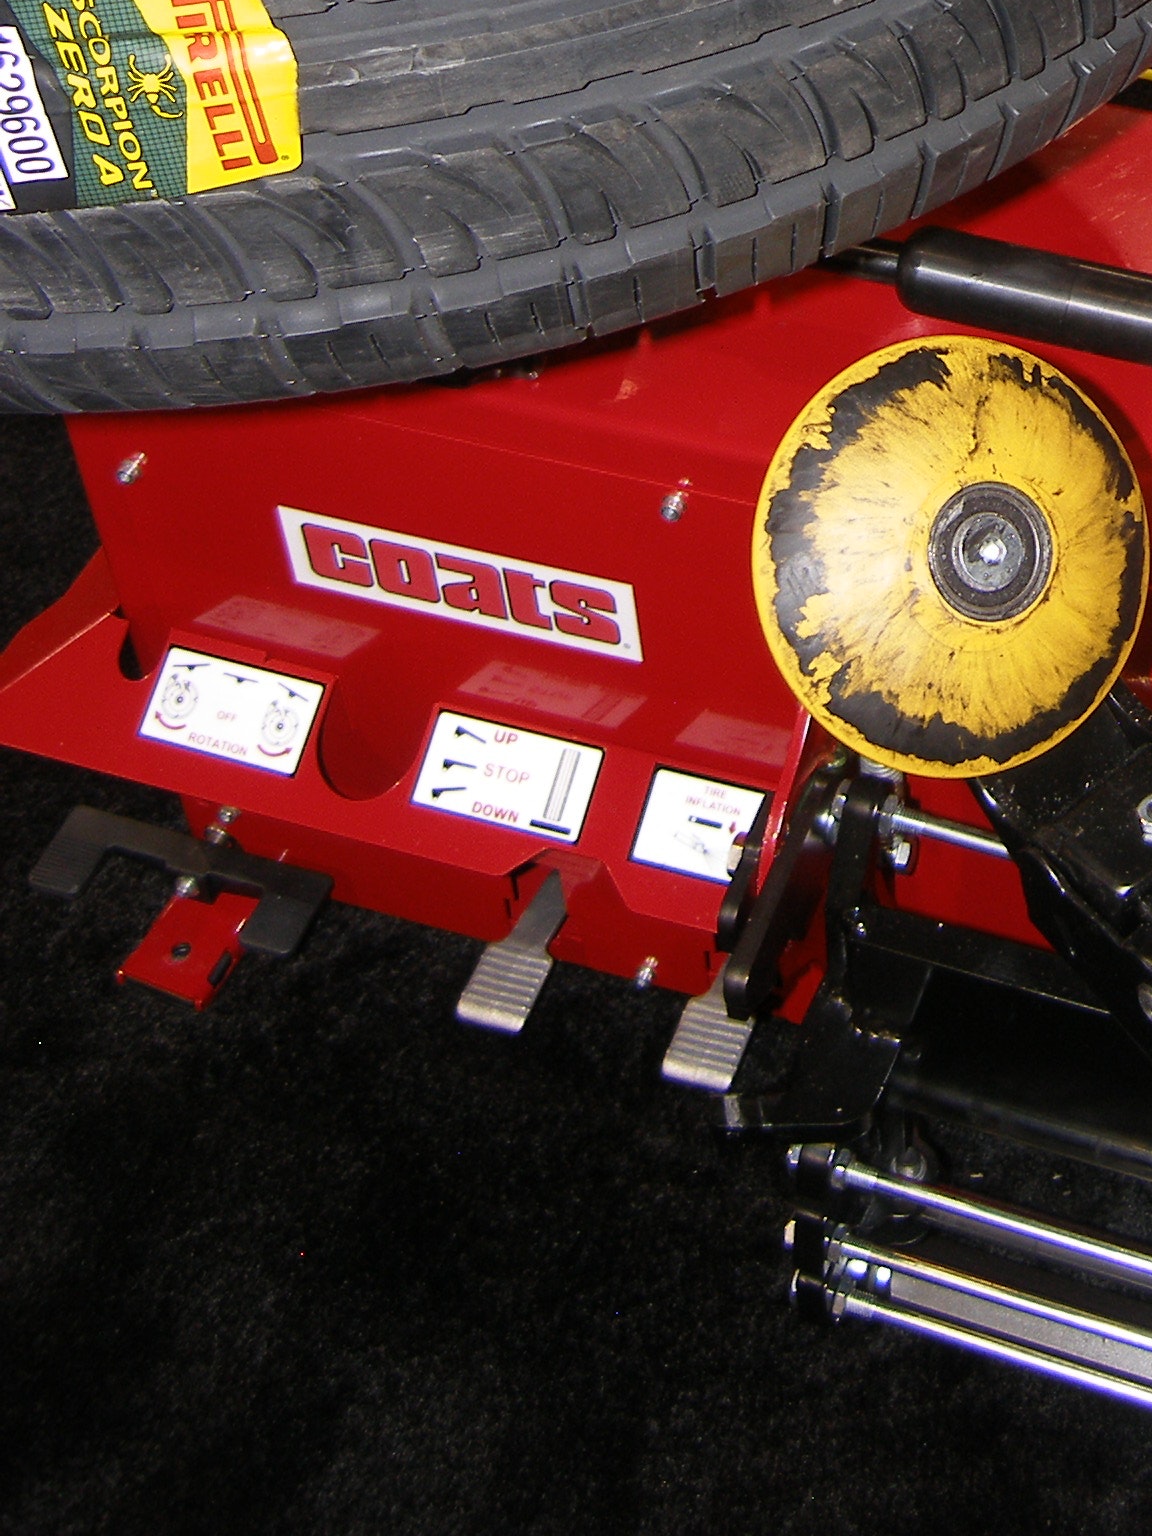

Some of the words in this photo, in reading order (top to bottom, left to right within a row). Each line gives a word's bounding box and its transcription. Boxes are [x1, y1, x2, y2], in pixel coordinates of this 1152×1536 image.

[42, 2, 111, 146] ZERO
[93, 153, 124, 186] A
[216, 710, 237, 722] OFF
[188, 731, 249, 756] ROTATION
[493, 729, 519, 745] UP
[483, 763, 530, 784] STOP
[704, 785, 728, 799] TIRE
[471, 800, 520, 823] DOWN
[685, 795, 741, 816] INFLATION
